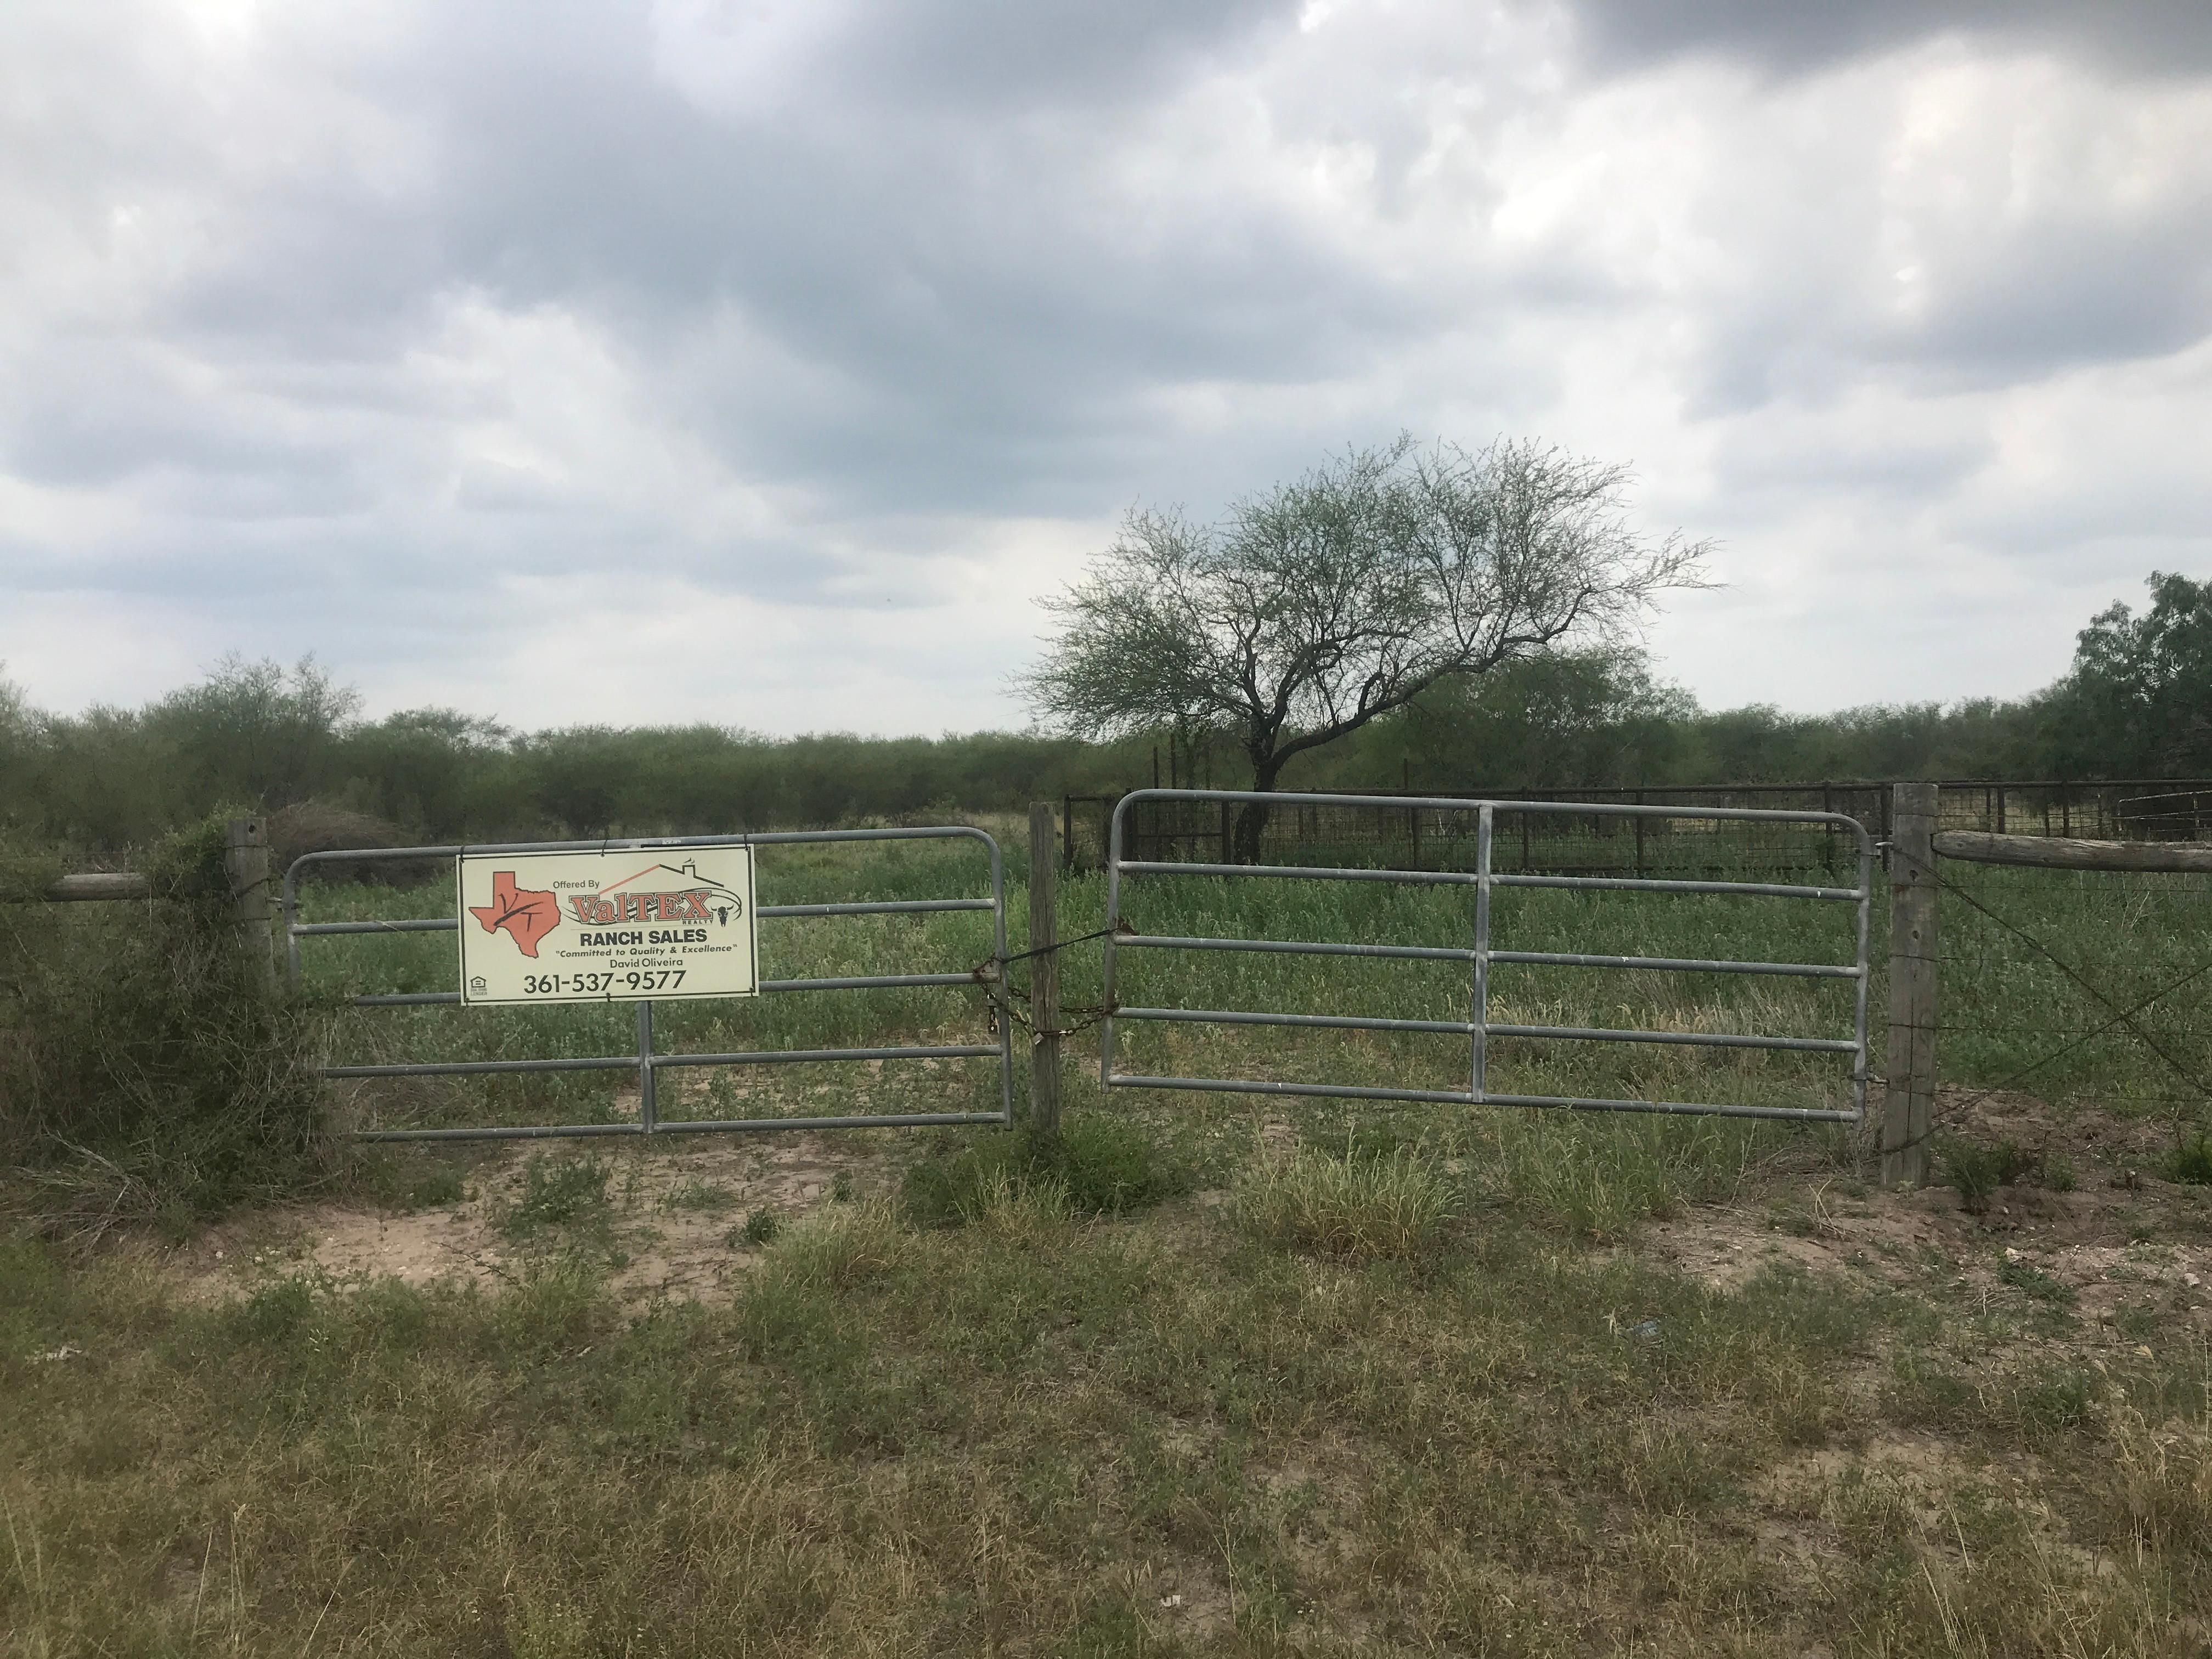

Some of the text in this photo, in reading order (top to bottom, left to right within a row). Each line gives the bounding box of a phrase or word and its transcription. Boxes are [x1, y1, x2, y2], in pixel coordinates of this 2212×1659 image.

[553, 880, 600, 889] Offered By
[569, 890, 713, 924] ValTEX
[580, 928, 707, 946] RANCH SALES
[556, 948, 612, 957] "Committed
[629, 947, 665, 956] Quality
[682, 944, 737, 953] Excellence"
[610, 957, 683, 968] David Oliveira
[523, 969, 687, 994] 361-537-9577
